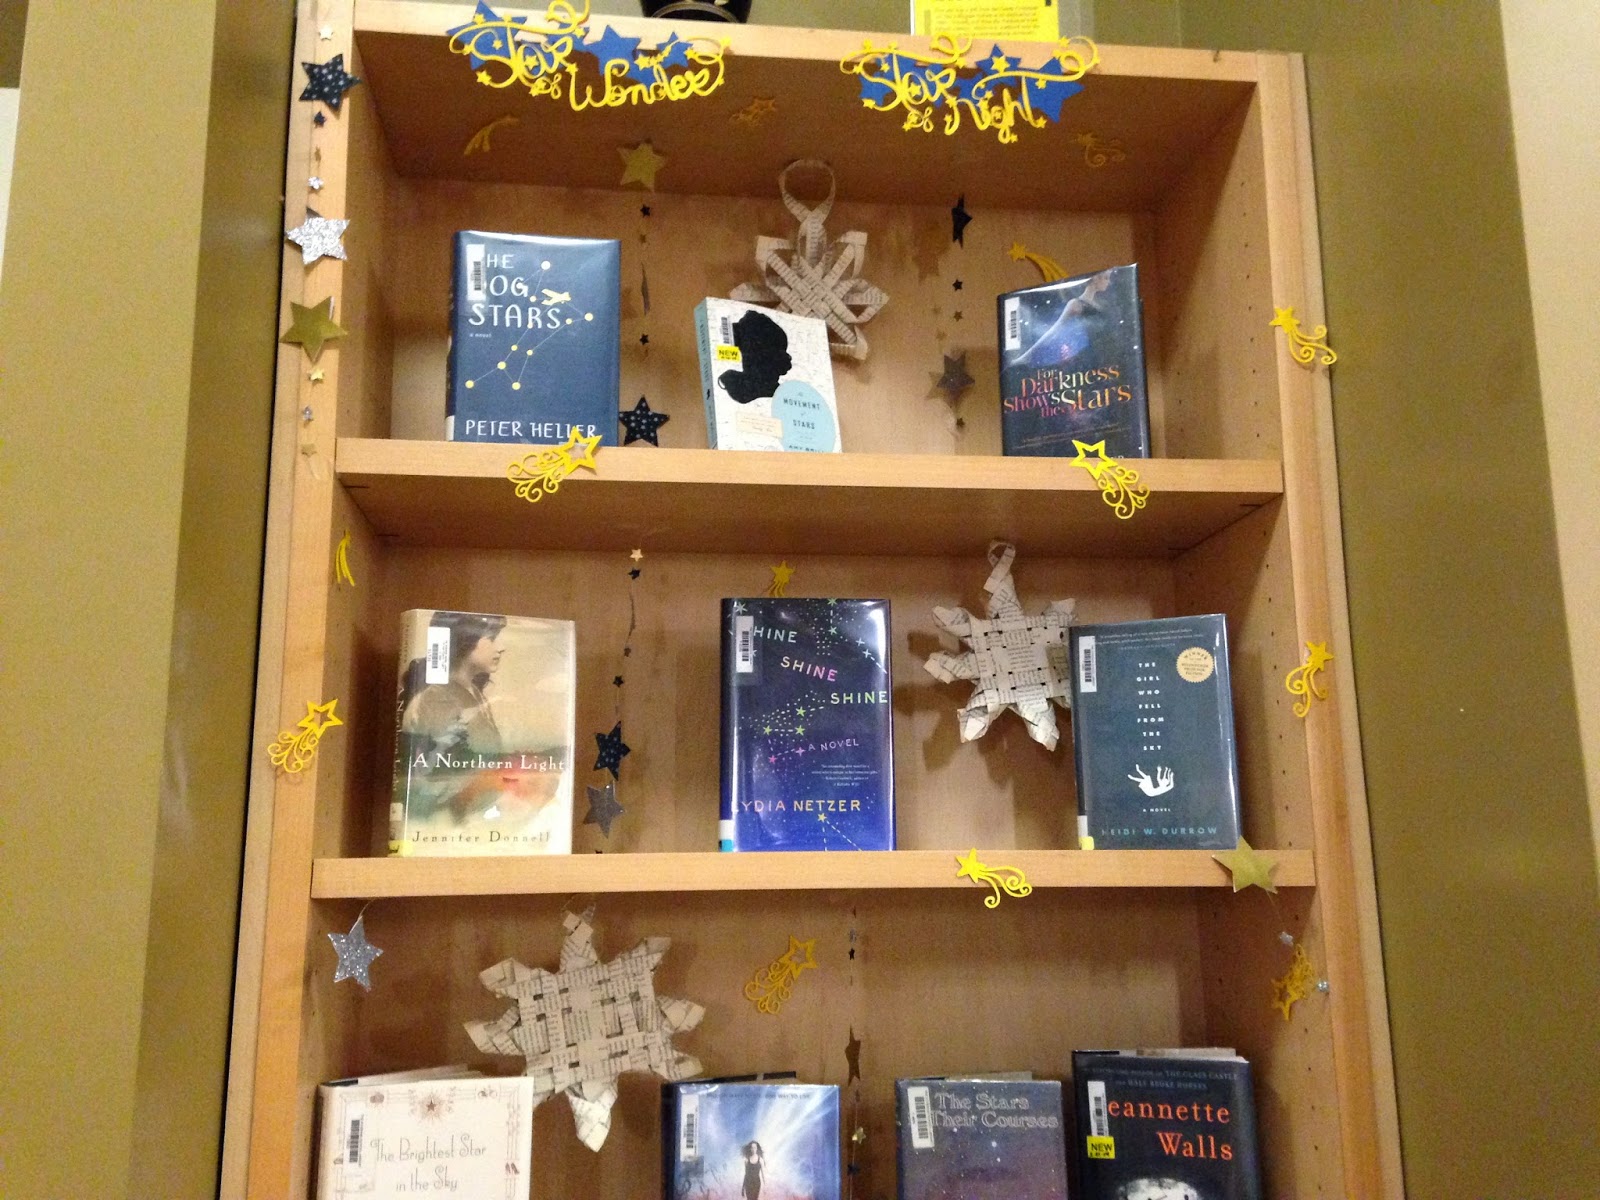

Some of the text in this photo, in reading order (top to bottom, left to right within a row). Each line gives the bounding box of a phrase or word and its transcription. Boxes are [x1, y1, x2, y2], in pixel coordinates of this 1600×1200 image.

[450, 20, 578, 88] Star
[841, 46, 957, 111] Star
[486, 253, 515, 269] HE
[489, 275, 529, 297] OG
[468, 304, 561, 329] STARS
[718, 349, 738, 357] NEW
[1020, 365, 1121, 397] Darkness
[783, 398, 820, 411] MOVEMENT
[1061, 385, 1133, 412] Stars
[465, 419, 524, 437] PETER
[792, 419, 816, 429] STARS
[753, 626, 798, 643] HINE
[780, 656, 838, 682] SHINE
[830, 691, 888, 704] SHINE
[808, 738, 860, 751] A NOVEL
[412, 753, 566, 772] A Northern Light
[793, 800, 861, 812] NETZER
[411, 830, 551, 843] Jennifer Donnell
[1162, 827, 1218, 836] DURROW
[934, 1092, 1030, 1110] The Stars
[981, 1111, 1059, 1129] Courses
[1107, 1100, 1231, 1124] eannette
[369, 1132, 487, 1164] The Brightest Star
[1091, 1143, 1113, 1152] NEW
[1156, 1131, 1234, 1161] Walls
[410, 1167, 429, 1192] the
[433, 1164, 458, 1192] Sky
